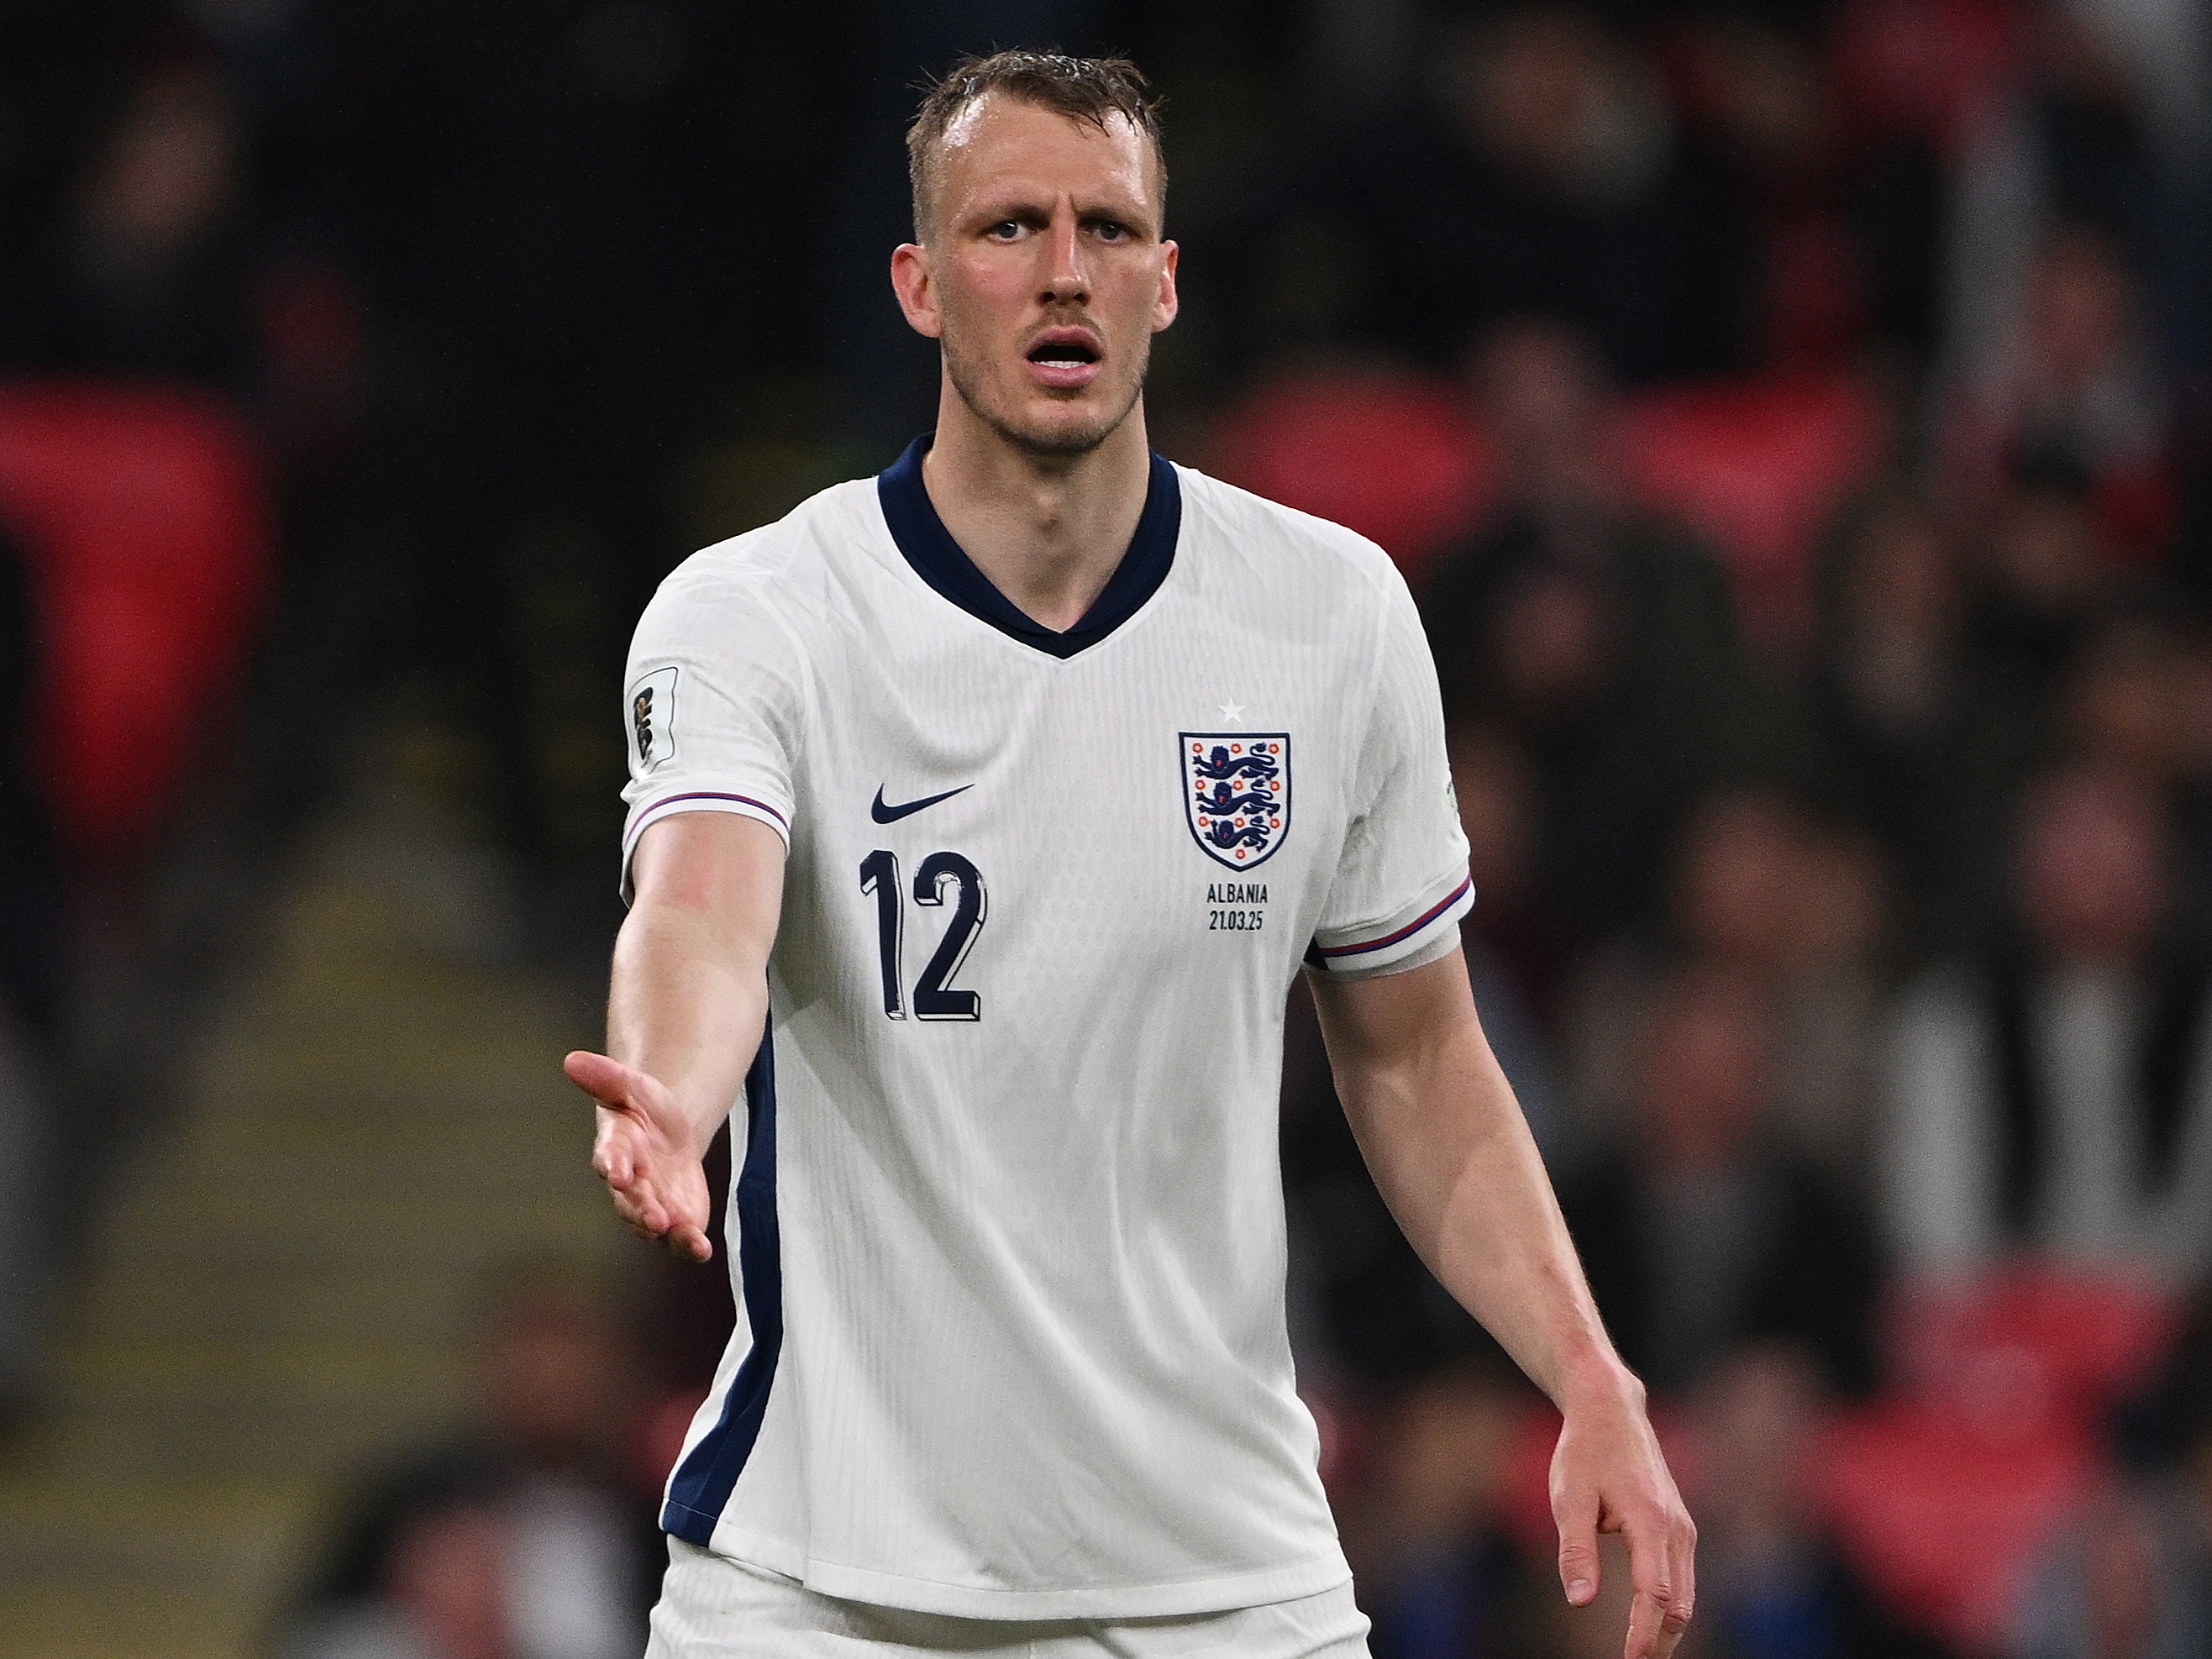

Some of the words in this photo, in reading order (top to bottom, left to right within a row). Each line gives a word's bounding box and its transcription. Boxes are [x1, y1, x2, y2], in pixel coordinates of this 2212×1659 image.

[1206, 883, 1268, 904] ALBANIA
[1209, 910, 1263, 931] 21.03.25
[859, 850, 988, 1021] 12
